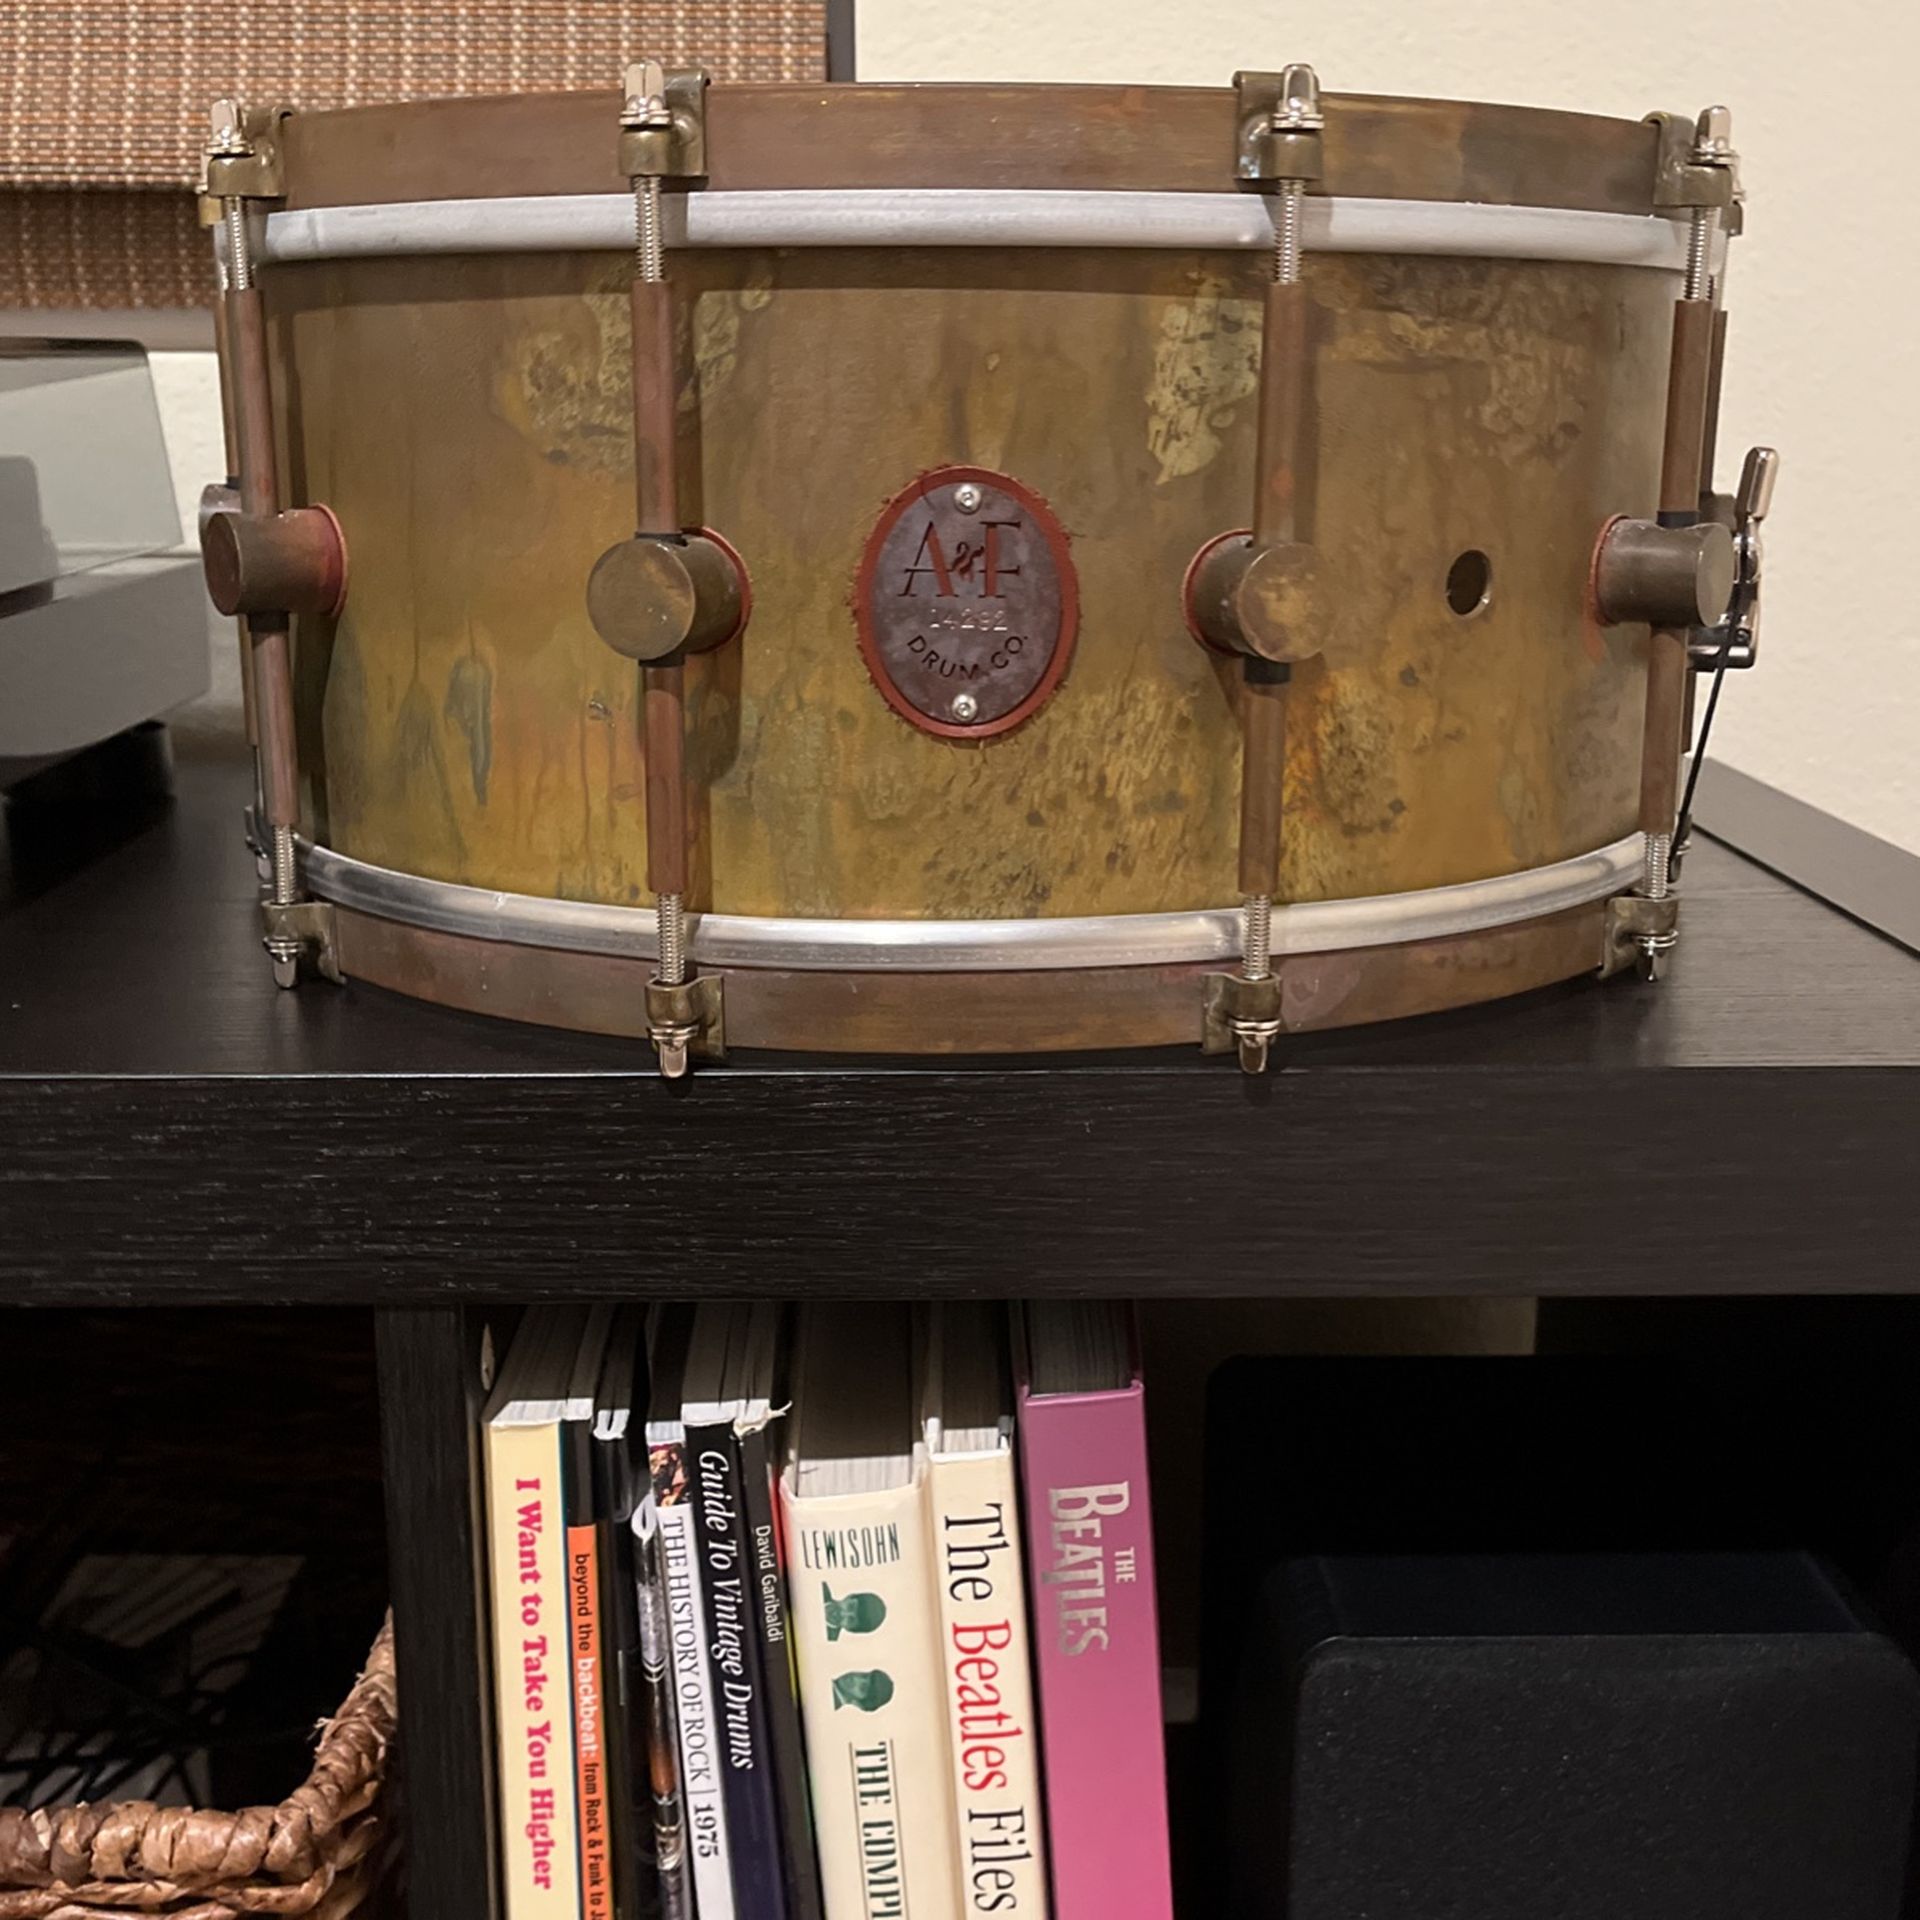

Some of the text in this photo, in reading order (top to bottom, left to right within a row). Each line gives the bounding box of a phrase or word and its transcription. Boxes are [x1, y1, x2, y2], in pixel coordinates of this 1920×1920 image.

[907, 635, 989, 680] DRUM
[801, 1522, 900, 1570] LEWISOHN
[1043, 1480, 1136, 1657] THE BEATLES
[572, 1553, 592, 1617] beyond
[700, 1451, 753, 1770] Guide To Vintage Drums
[755, 1525, 784, 1643] David Garibaldi
[578, 1623, 593, 1651] the
[515, 1478, 555, 1889] I Want to Take You Higher
[577, 1657, 600, 1758] backbeat:
[663, 1516, 719, 1858] THE HISTORY OF ROCK 1975
[944, 1503, 1033, 1912] The Beatles Files
[584, 1762, 600, 1795] from
[855, 1741, 891, 1806] THE
[585, 1799, 602, 1834] Rock
[587, 1839, 603, 1849] &
[587, 1854, 605, 1887] Funk
[589, 1892, 605, 1906] to
